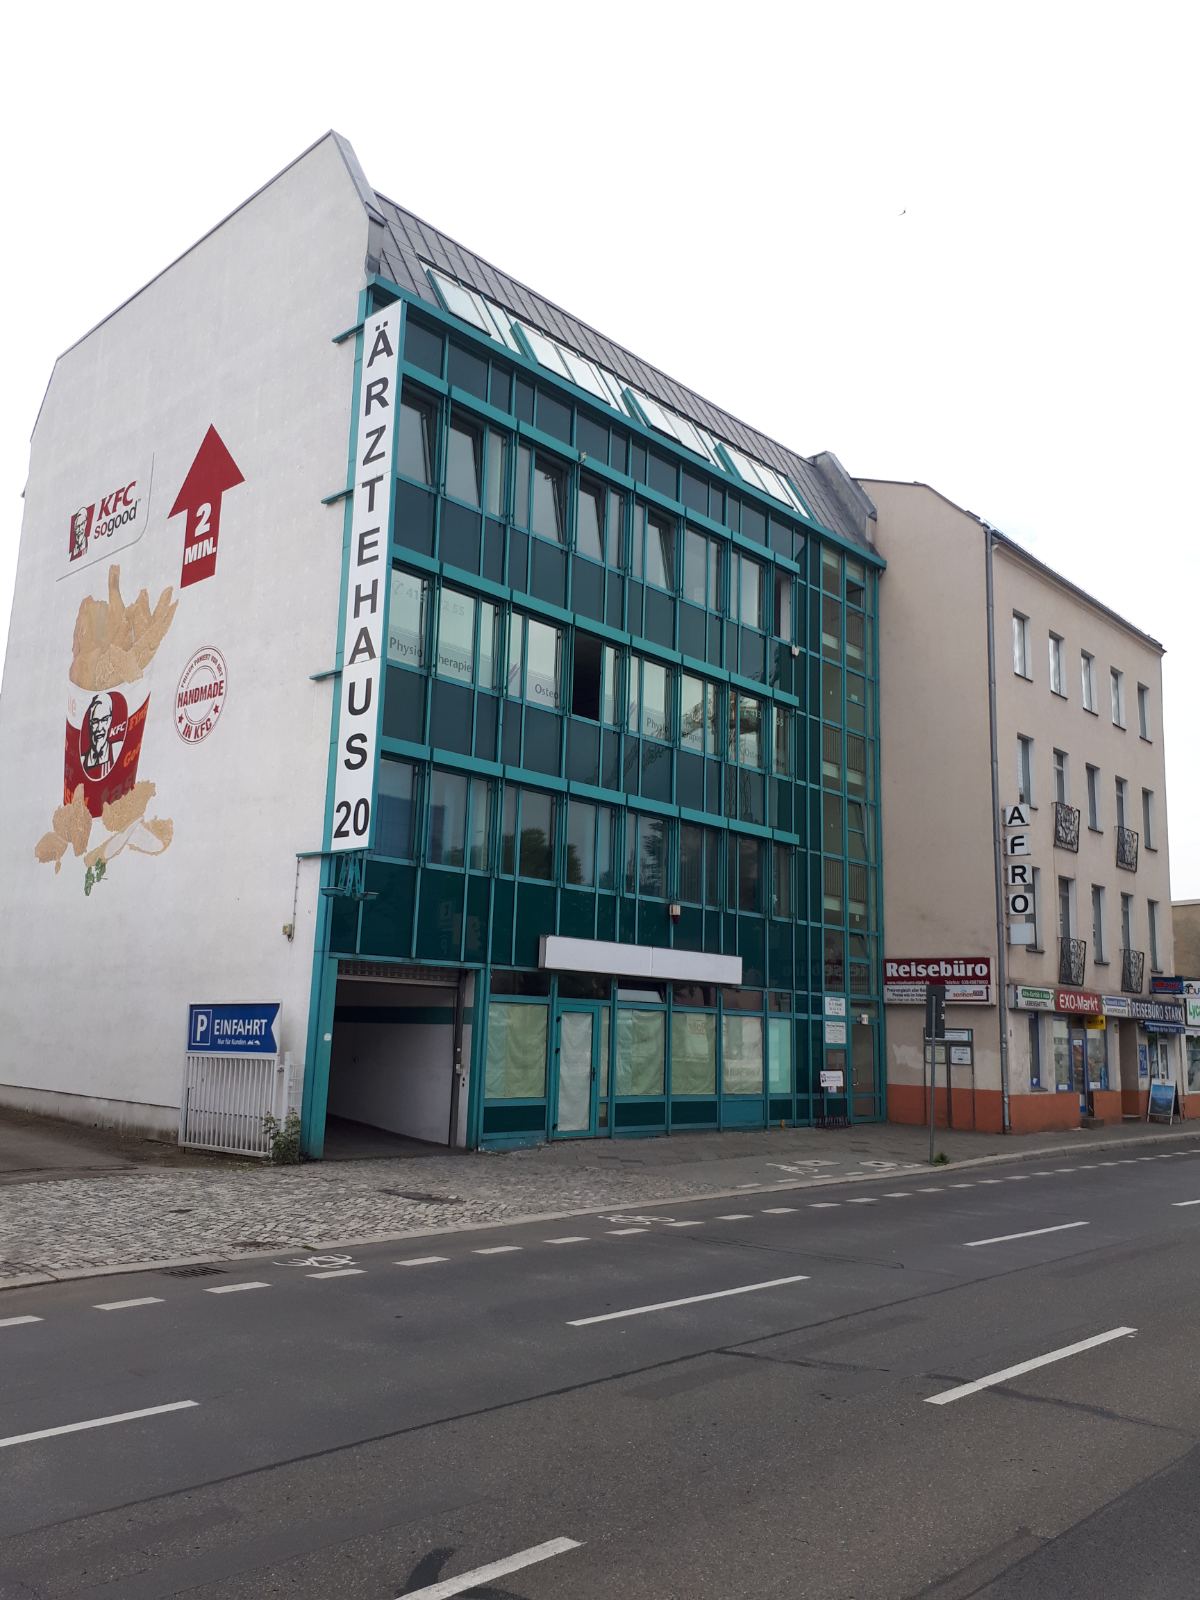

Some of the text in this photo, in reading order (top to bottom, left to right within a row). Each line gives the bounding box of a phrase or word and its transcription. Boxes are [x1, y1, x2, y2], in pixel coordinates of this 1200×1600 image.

[97, 481, 137, 522] KFC
[194, 502, 212, 537] 2
[184, 537, 217, 565] MIN.
[343, 322, 393, 771] ÄRZTEHAUS
[389, 637, 472, 673] Physio herapie
[177, 680, 225, 708] HANDMADE
[109, 721, 127, 738] KFC
[182, 717, 212, 740] IN KFC
[334, 797, 370, 839] 20
[1007, 806, 1029, 914] AFRO
[885, 960, 988, 977] Reisebüro
[1059, 994, 1099, 1011] EXO-Markt
[1131, 1001, 1164, 1019] REISEBÜRO
[1164, 1005, 1184, 1021] STARK
[213, 1018, 268, 1036] EINFAHRT
